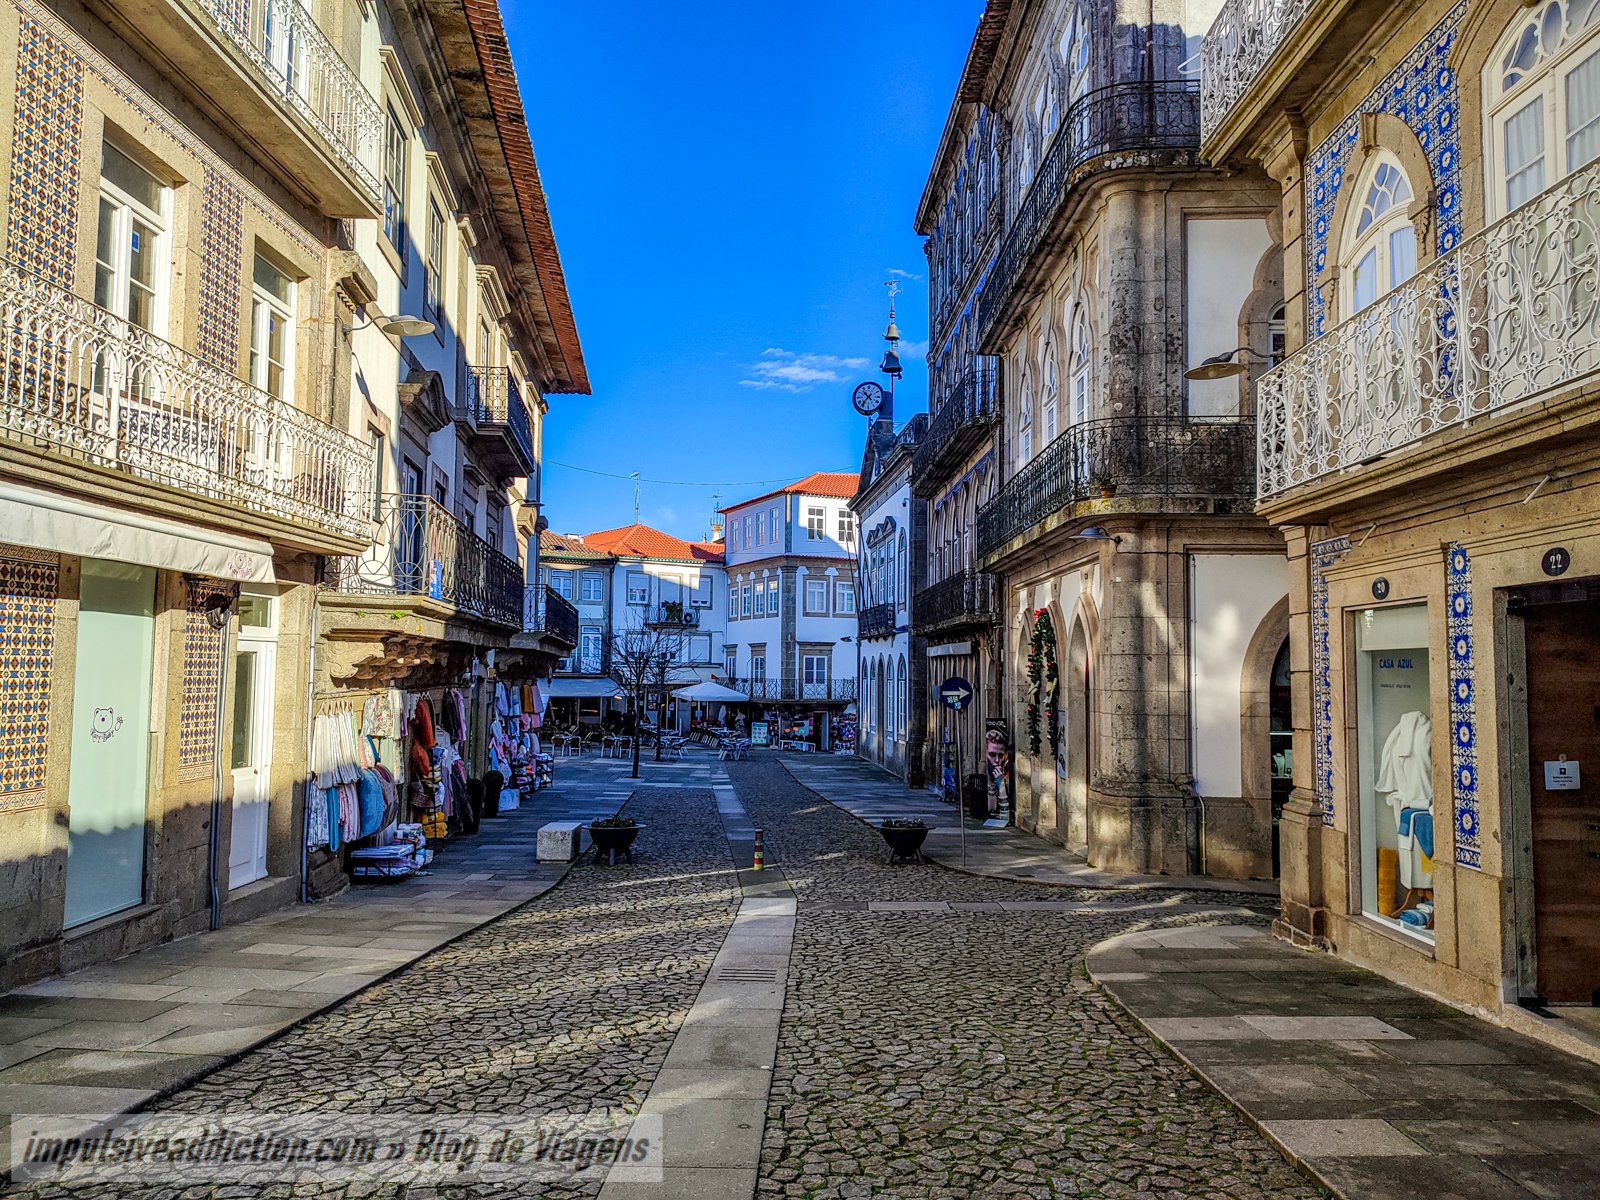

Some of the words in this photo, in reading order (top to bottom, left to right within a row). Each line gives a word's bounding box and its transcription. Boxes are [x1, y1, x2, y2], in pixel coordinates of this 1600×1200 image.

[1550, 553, 1562, 569] 22
[1376, 581, 1386, 594] 20
[1379, 658, 1395, 669] CASA
[1397, 658, 1414, 669] AZUL
